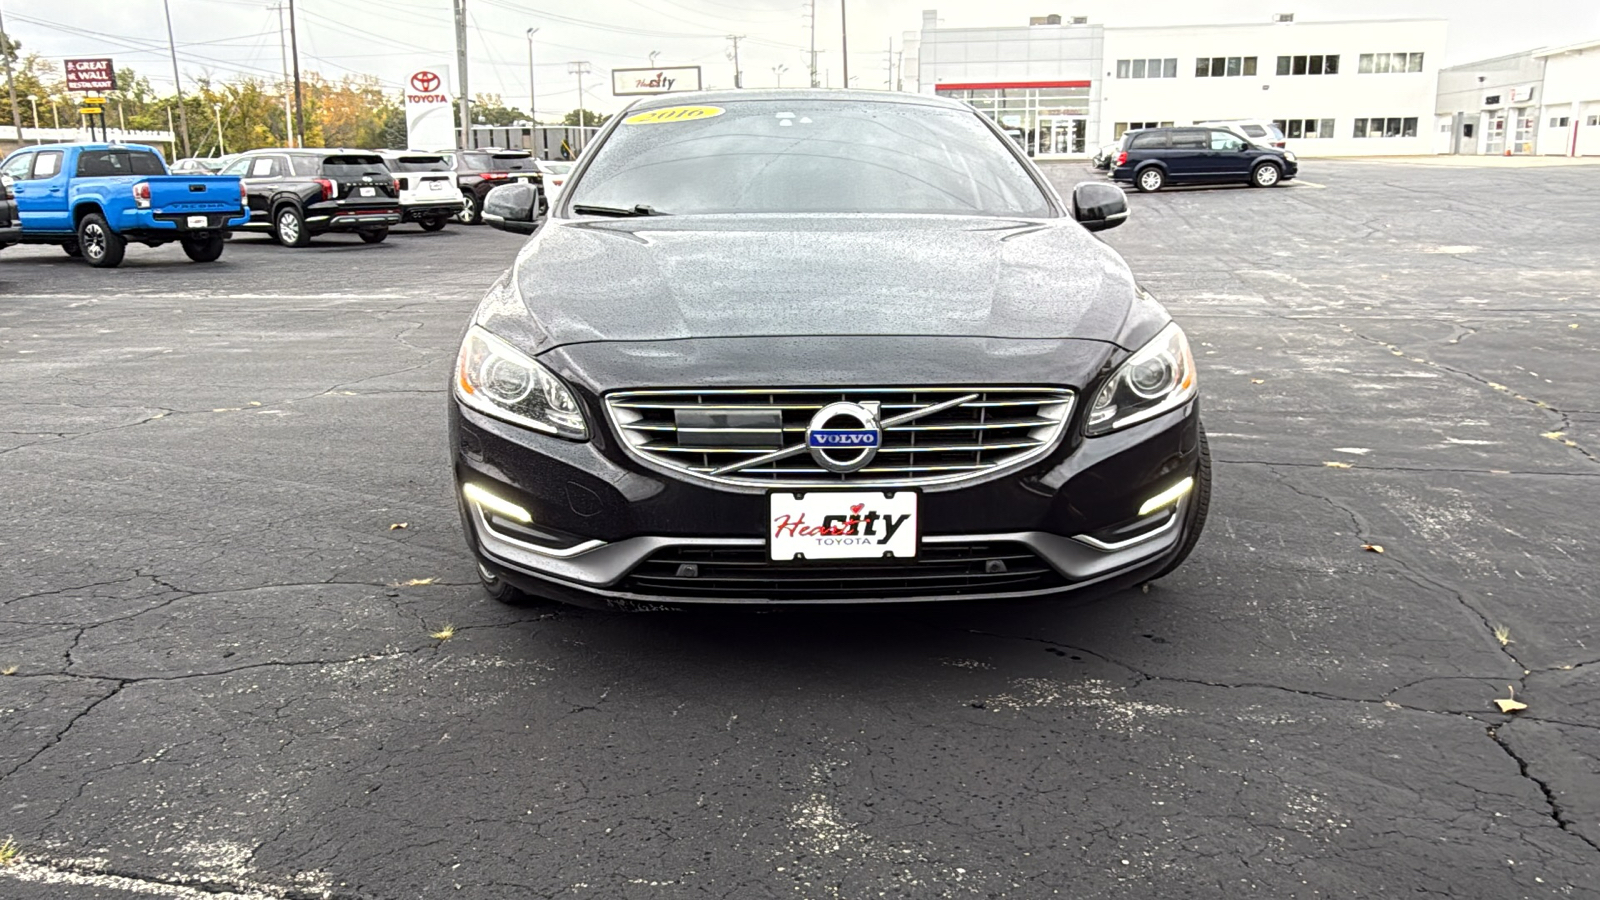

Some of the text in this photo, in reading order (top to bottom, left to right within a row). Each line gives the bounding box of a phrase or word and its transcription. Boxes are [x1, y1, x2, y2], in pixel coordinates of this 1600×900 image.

[75, 61, 108, 70] GREAT
[77, 71, 109, 80] WALL
[407, 94, 448, 104] TOYOTA
[813, 434, 874, 443] VOLVO
[774, 503, 912, 545] Heart city
[816, 538, 872, 546] TOYOTA
